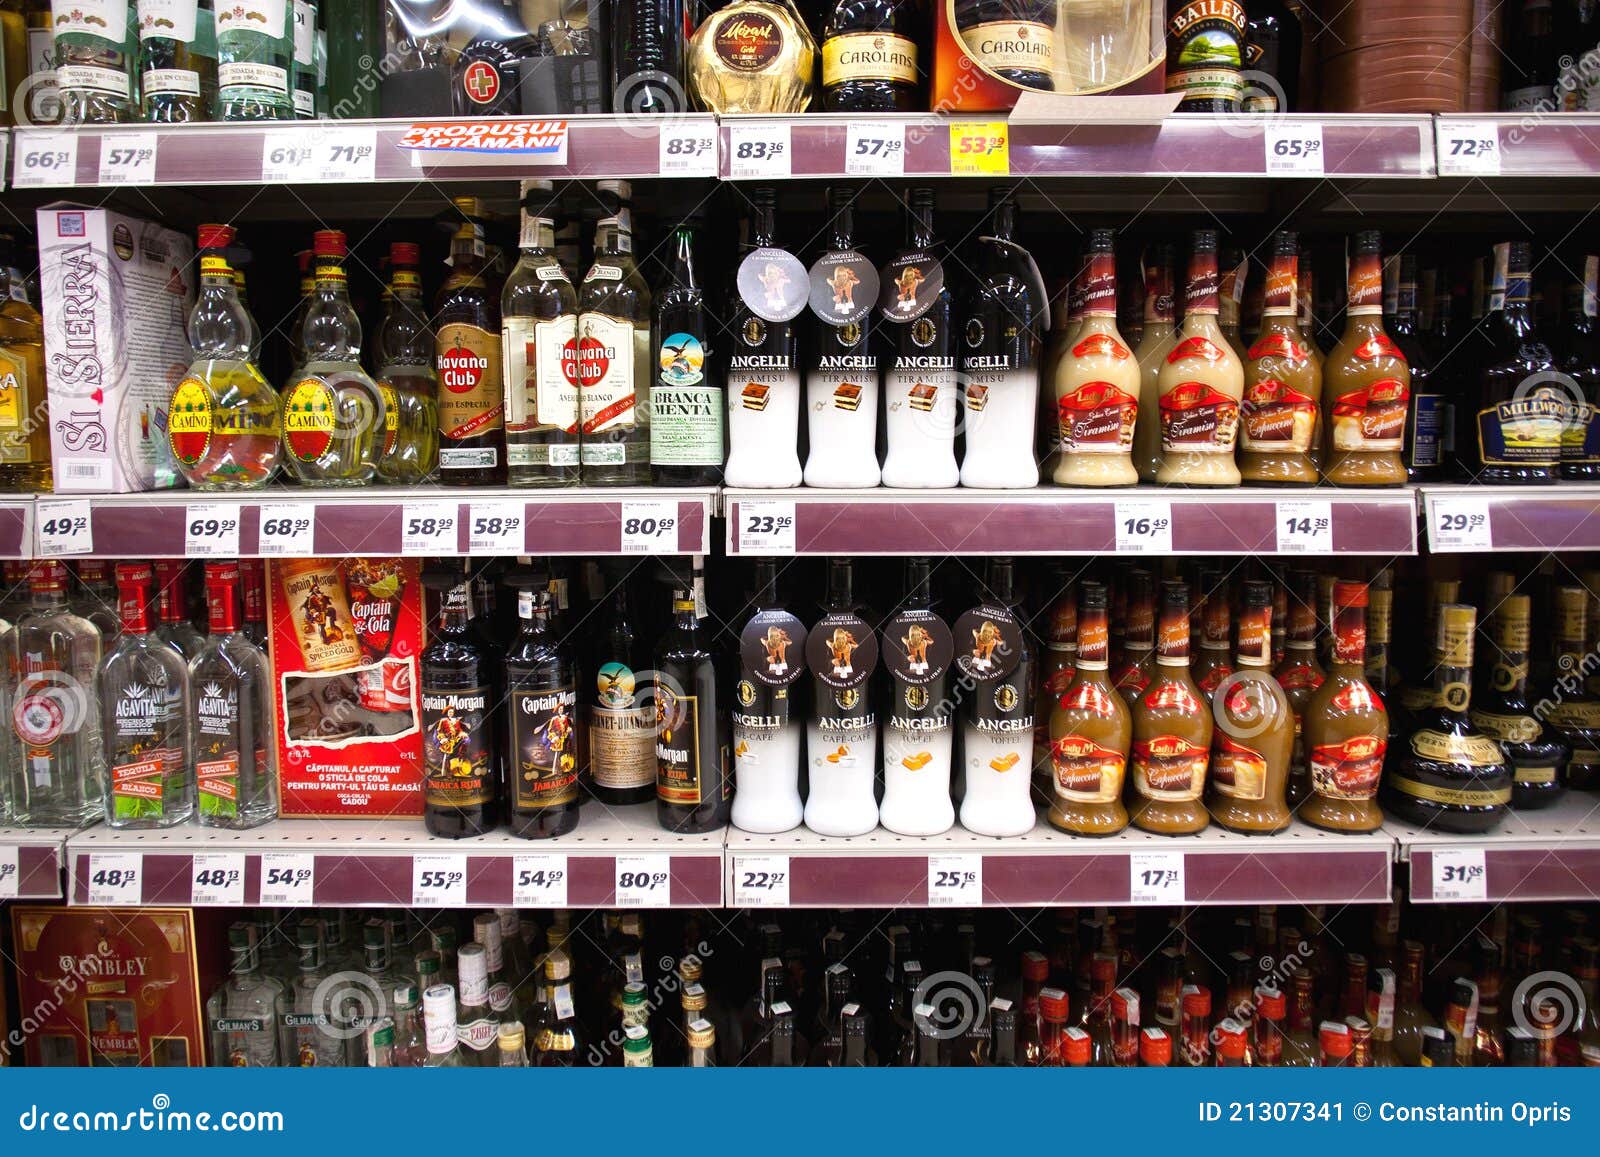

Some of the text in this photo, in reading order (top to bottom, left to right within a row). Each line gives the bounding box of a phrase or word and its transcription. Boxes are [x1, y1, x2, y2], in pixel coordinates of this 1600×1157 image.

[1174, 0, 1247, 30] BAILEYS
[721, 20, 773, 41] Mozart
[981, 40, 1051, 58] CAROLANS
[841, 50, 913, 68] CAROLANS
[405, 121, 567, 138] PRODUSUL
[736, 142, 784, 160] 83,36
[855, 139, 902, 158] 57,49
[1273, 139, 1321, 158] 65,99
[437, 355, 488, 370] Havana
[731, 355, 789, 367] ANGELLI
[819, 355, 877, 368] ANGELLI
[895, 356, 954, 368] ANGELLI
[963, 355, 1010, 369] NGELLI
[444, 371, 476, 386] Club
[732, 374, 786, 383] TIRAMISU
[823, 374, 873, 383] TIRAMISU
[897, 374, 951, 384] TIRAMISU
[587, 393, 613, 401] BLANCO
[655, 392, 712, 404] BRANCA
[655, 405, 711, 415] MENTA
[1502, 400, 1564, 417] MILLWOO
[43, 517, 87, 536] 49,22
[190, 519, 236, 538] 69,99
[263, 519, 309, 537] 68,99
[407, 518, 453, 537] 58,99
[474, 517, 520, 536] 58,99
[624, 518, 675, 537] 80,69
[747, 516, 792, 535] 23,96
[1124, 518, 1168, 537] 16,49
[1286, 518, 1328, 537] 14,38
[1439, 513, 1485, 533] 29,99
[351, 601, 392, 618] Captain
[367, 616, 390, 634] Cola
[309, 645, 354, 663] SPICED GOLD
[116, 699, 157, 717] AGAVITA
[199, 697, 229, 716] AGAVITA
[449, 694, 485, 711] Morgan
[522, 694, 556, 715] Captain
[819, 712, 875, 729] ANGELLI
[890, 715, 947, 730] ANGELLI
[977, 716, 1033, 731] ANGELLI
[658, 744, 687, 764] Morgan
[118, 764, 156, 777] TEQUILA
[201, 764, 231, 774] TEQUILA
[319, 773, 325, 781] O
[355, 774, 366, 782] DE
[367, 774, 389, 783] COLA
[359, 765, 401, 774] CAPTURAT
[122, 783, 157, 795] BLANCO
[204, 780, 232, 795] BLANCO
[287, 782, 320, 791] PENTRU
[321, 783, 361, 791] PARTY-UL
[379, 783, 389, 791] DE
[460, 778, 482, 789] RUM
[92, 870, 136, 888] 48,13
[196, 870, 240, 888] 48,13
[266, 868, 311, 888] 54,69
[420, 871, 462, 889] 55,99
[518, 870, 563, 889] 54,69
[619, 872, 667, 890] 80,69
[742, 872, 785, 890] 22,97
[934, 871, 976, 889] 25,16
[1140, 870, 1178, 888] 17,31
[1442, 864, 1484, 884] 31,06
